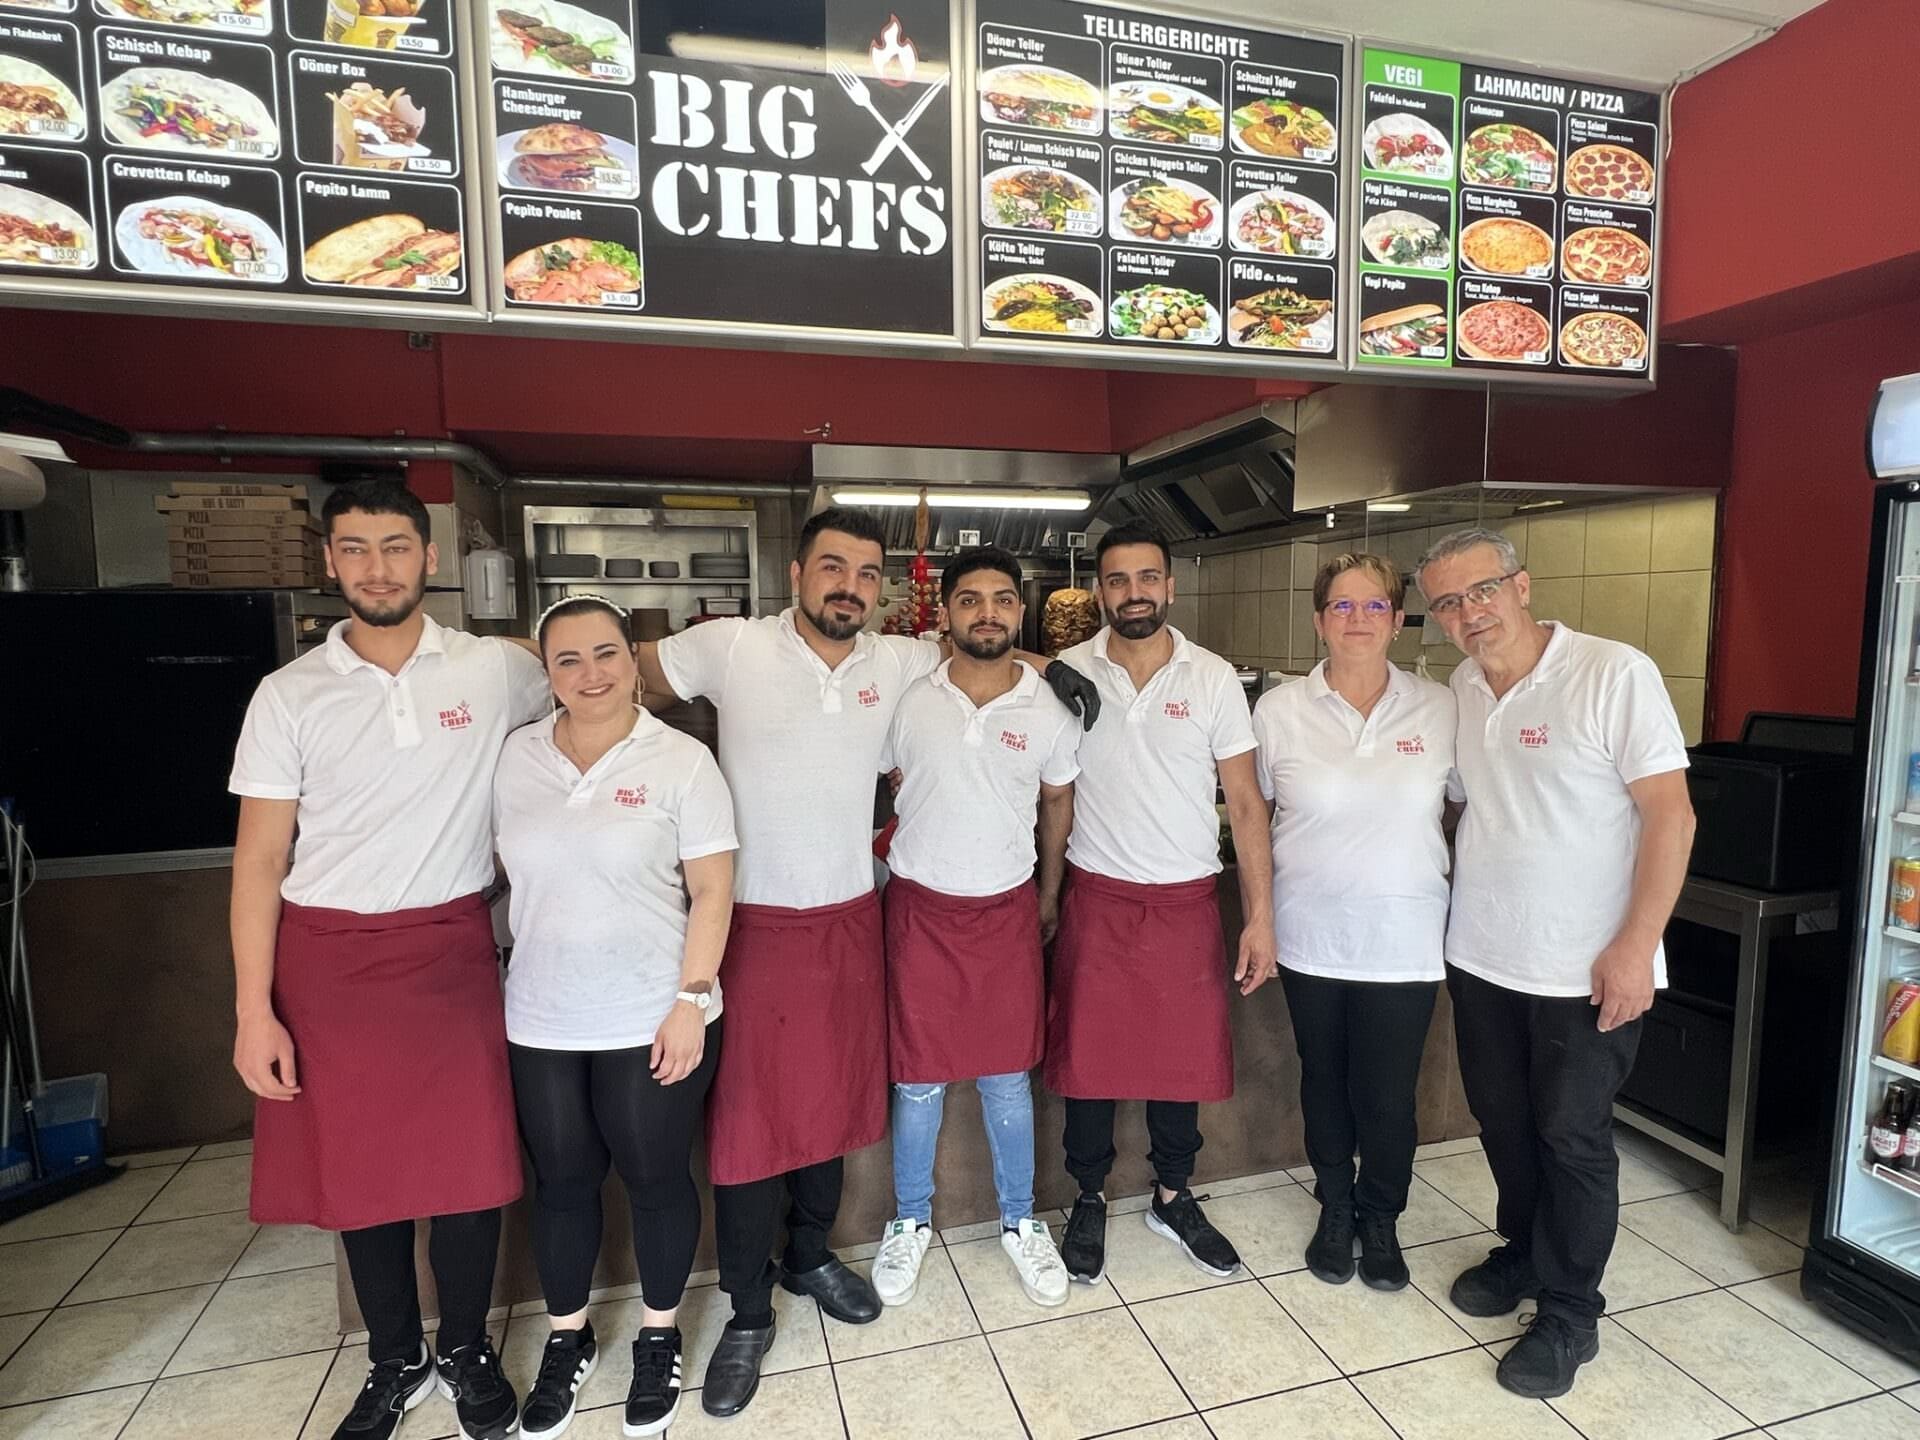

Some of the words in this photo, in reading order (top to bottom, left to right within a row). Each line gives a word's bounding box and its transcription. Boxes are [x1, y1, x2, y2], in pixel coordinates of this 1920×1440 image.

[986, 33, 1016, 49] Döner
[1017, 37, 1045, 52] Teller
[1083, 14, 1250, 59] TELLERGERICHTE
[106, 36, 163, 55] Schisch
[168, 43, 212, 63] Kebap
[108, 51, 141, 63] Lamm
[300, 57, 338, 75] Döner
[341, 63, 366, 77] Box
[1116, 52, 1144, 67] Döner
[1145, 56, 1172, 71] Teller
[1236, 70, 1273, 86] Schnitzel
[1274, 75, 1297, 90] Teller
[1384, 64, 1423, 87] VEGI
[502, 85, 566, 106] Hamburger
[1370, 91, 1395, 104] Falafel
[1474, 73, 1565, 104] LAHMACUN
[1568, 89, 1577, 108] /
[1580, 91, 1624, 113] PIZZA
[502, 99, 583, 121] Cheeseburger
[648, 70, 818, 160] BIG
[1470, 103, 1504, 118] Lahmacun
[1570, 117, 1586, 129] Pizza
[987, 149, 1010, 162] Teller
[988, 136, 1013, 151] Poulet
[1020, 141, 1043, 155] Lamm
[1045, 143, 1075, 157] Schisch
[1076, 147, 1100, 163] Kebap
[1115, 152, 1148, 166] Chicken
[1150, 156, 1184, 171] Nuggets
[1186, 161, 1208, 174] Teller
[113, 162, 183, 182] Crevetten
[187, 169, 231, 188] Kebap
[1236, 167, 1275, 182] Crevetten
[1276, 171, 1298, 184] Teller
[306, 180, 348, 197] Pepito
[351, 185, 391, 200] Lamm
[1365, 182, 1381, 195] Vegi
[1365, 196, 1380, 206] Feta
[1382, 198, 1397, 208] Käse
[1466, 194, 1482, 205] Pizza
[505, 202, 543, 219] Pepito
[545, 206, 582, 221] Poulet
[652, 161, 948, 256] CHEFS
[1567, 205, 1582, 215] Pizza
[53, 248, 79, 260] 13.00
[989, 240, 1015, 253] Köfte
[1017, 242, 1045, 256] Teller
[1117, 252, 1148, 265] Falafel
[1150, 254, 1176, 268] Teller
[1234, 263, 1263, 281] Pide
[1365, 276, 1380, 289] Vegi
[1382, 278, 1406, 290] Pepito
[1465, 281, 1481, 293] Pizza
[1564, 290, 1579, 301] Pizza
[188, 512, 210, 523] PIZZA
[183, 527, 205, 539] PIZZA
[187, 543, 207, 553] PIZZA
[187, 559, 208, 570] PIZZA
[189, 574, 209, 585] PIZZA
